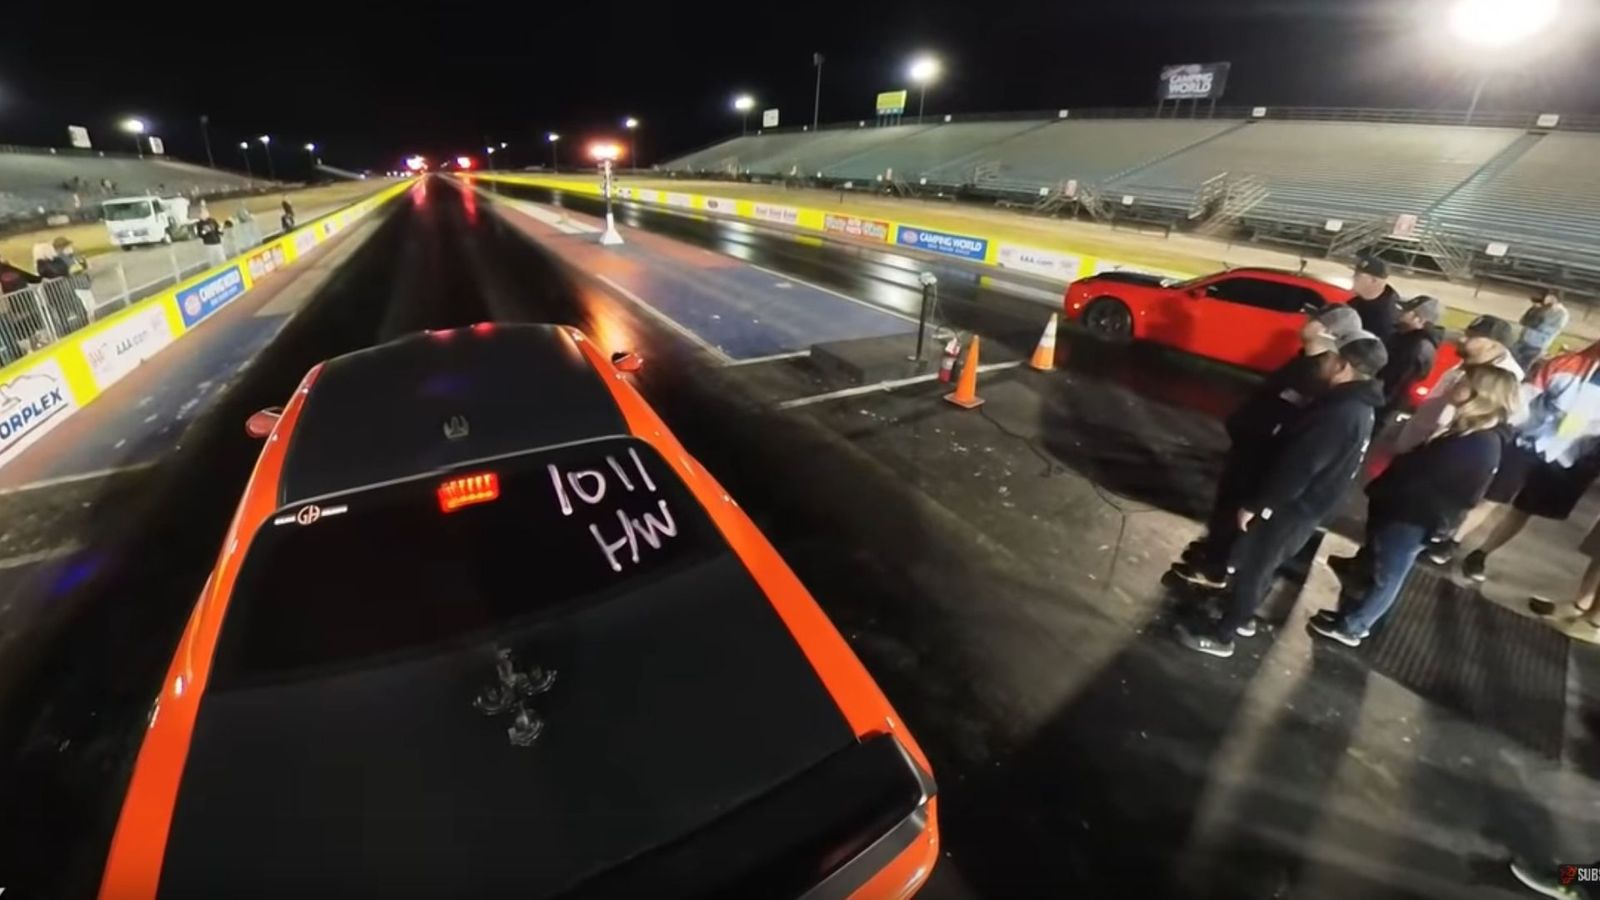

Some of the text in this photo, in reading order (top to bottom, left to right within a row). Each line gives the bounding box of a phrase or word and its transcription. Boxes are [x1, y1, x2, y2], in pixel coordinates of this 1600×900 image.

[1169, 82, 1211, 94] WORLD
[920, 232, 952, 246] CAMPING
[952, 238, 982, 252] WORLD
[547, 447, 656, 516] 1011
[589, 500, 677, 571] HW
